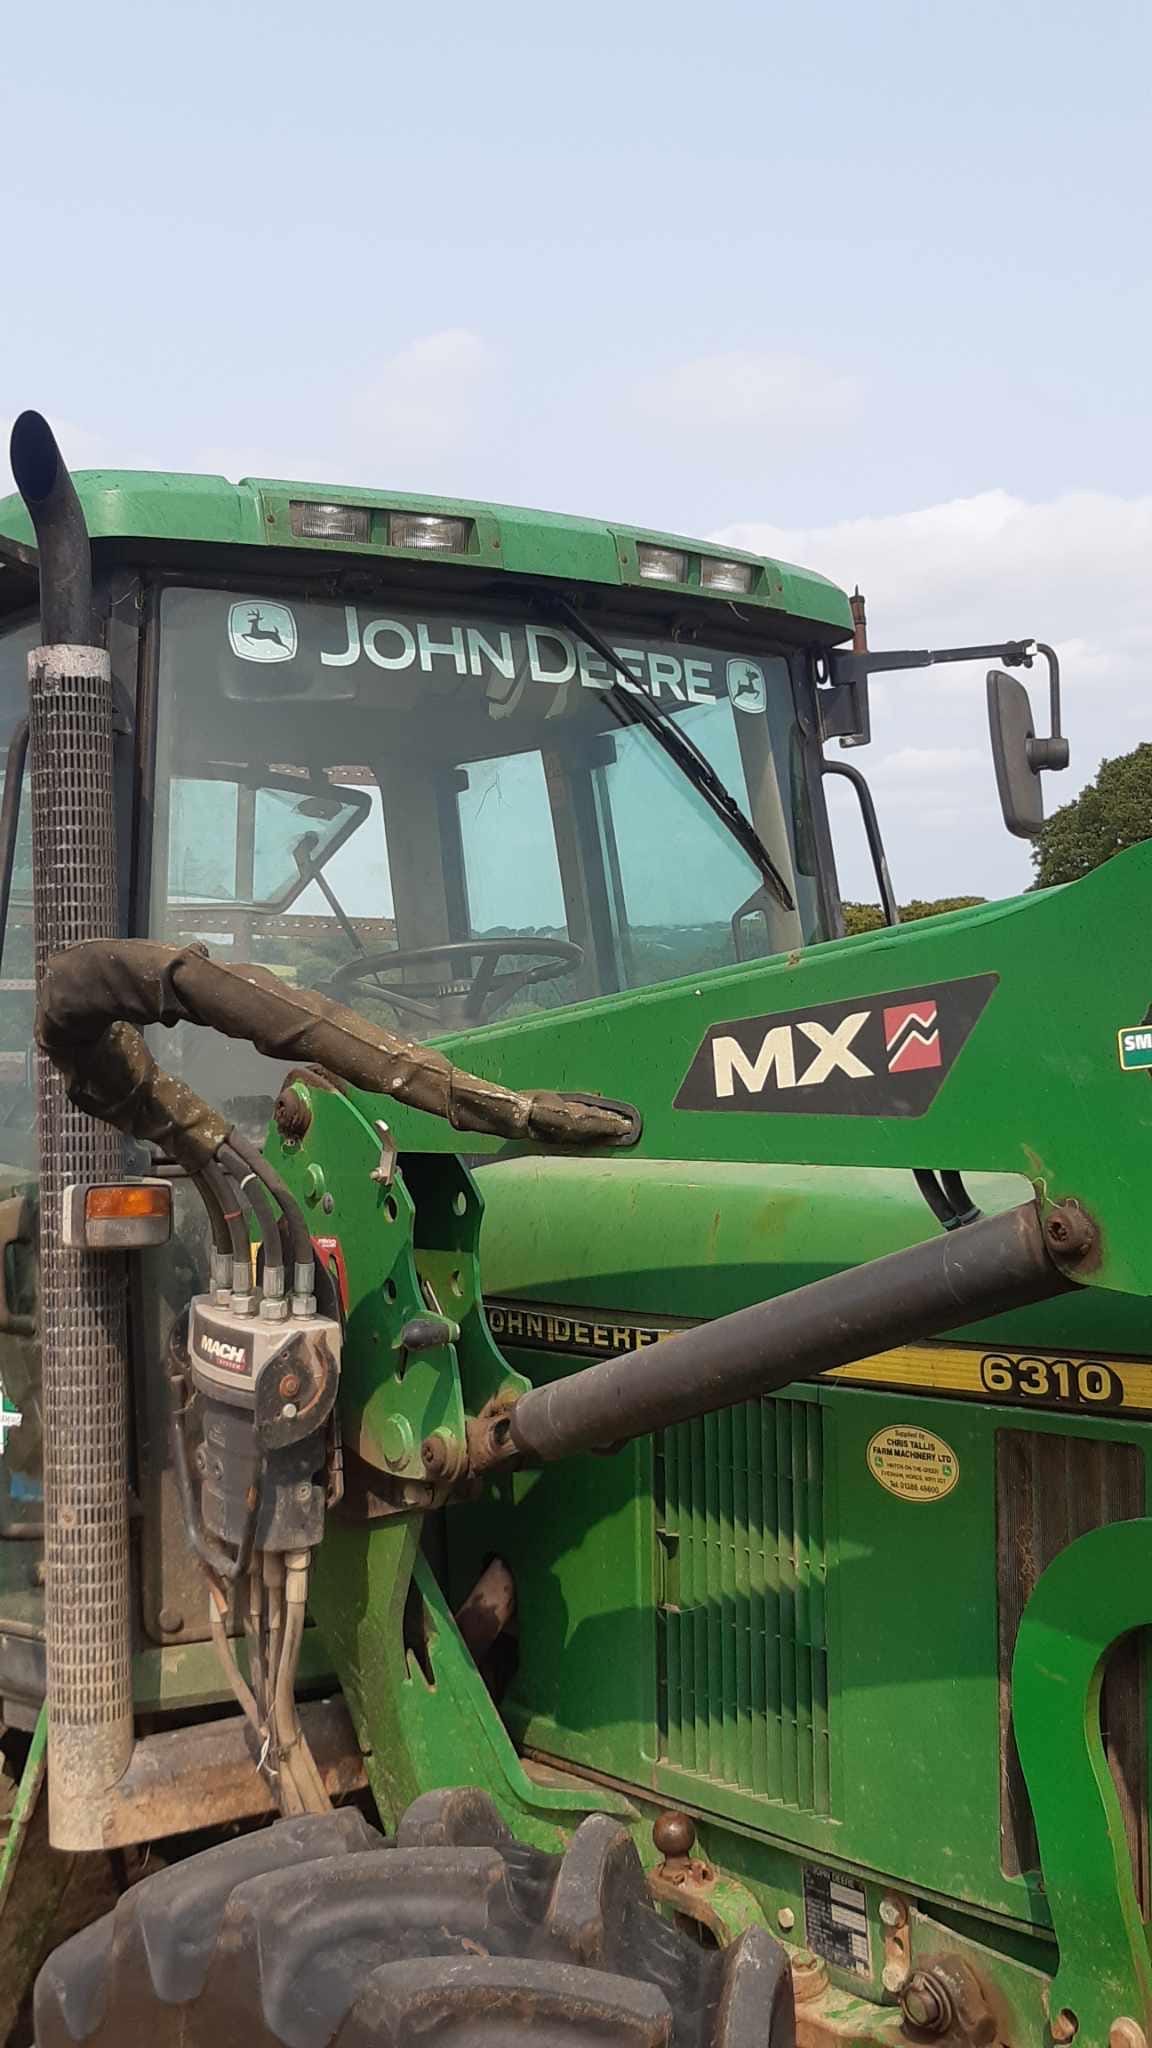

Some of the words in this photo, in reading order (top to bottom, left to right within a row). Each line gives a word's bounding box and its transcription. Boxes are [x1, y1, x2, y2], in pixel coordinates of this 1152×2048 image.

[321, 606, 515, 679] JOHN
[525, 624, 717, 705] DEERE
[711, 1010, 875, 1098] MX
[488, 1308, 543, 1339] OHN
[201, 1334, 245, 1363] MACH
[982, 1355, 1113, 1402] 6310
[873, 1446, 893, 1456] FARM
[893, 1448, 936, 1461] MACHINERY
[937, 1454, 952, 1463] LTD
[886, 1438, 909, 1448] CHRIS
[910, 1440, 936, 1451] TALLIS
